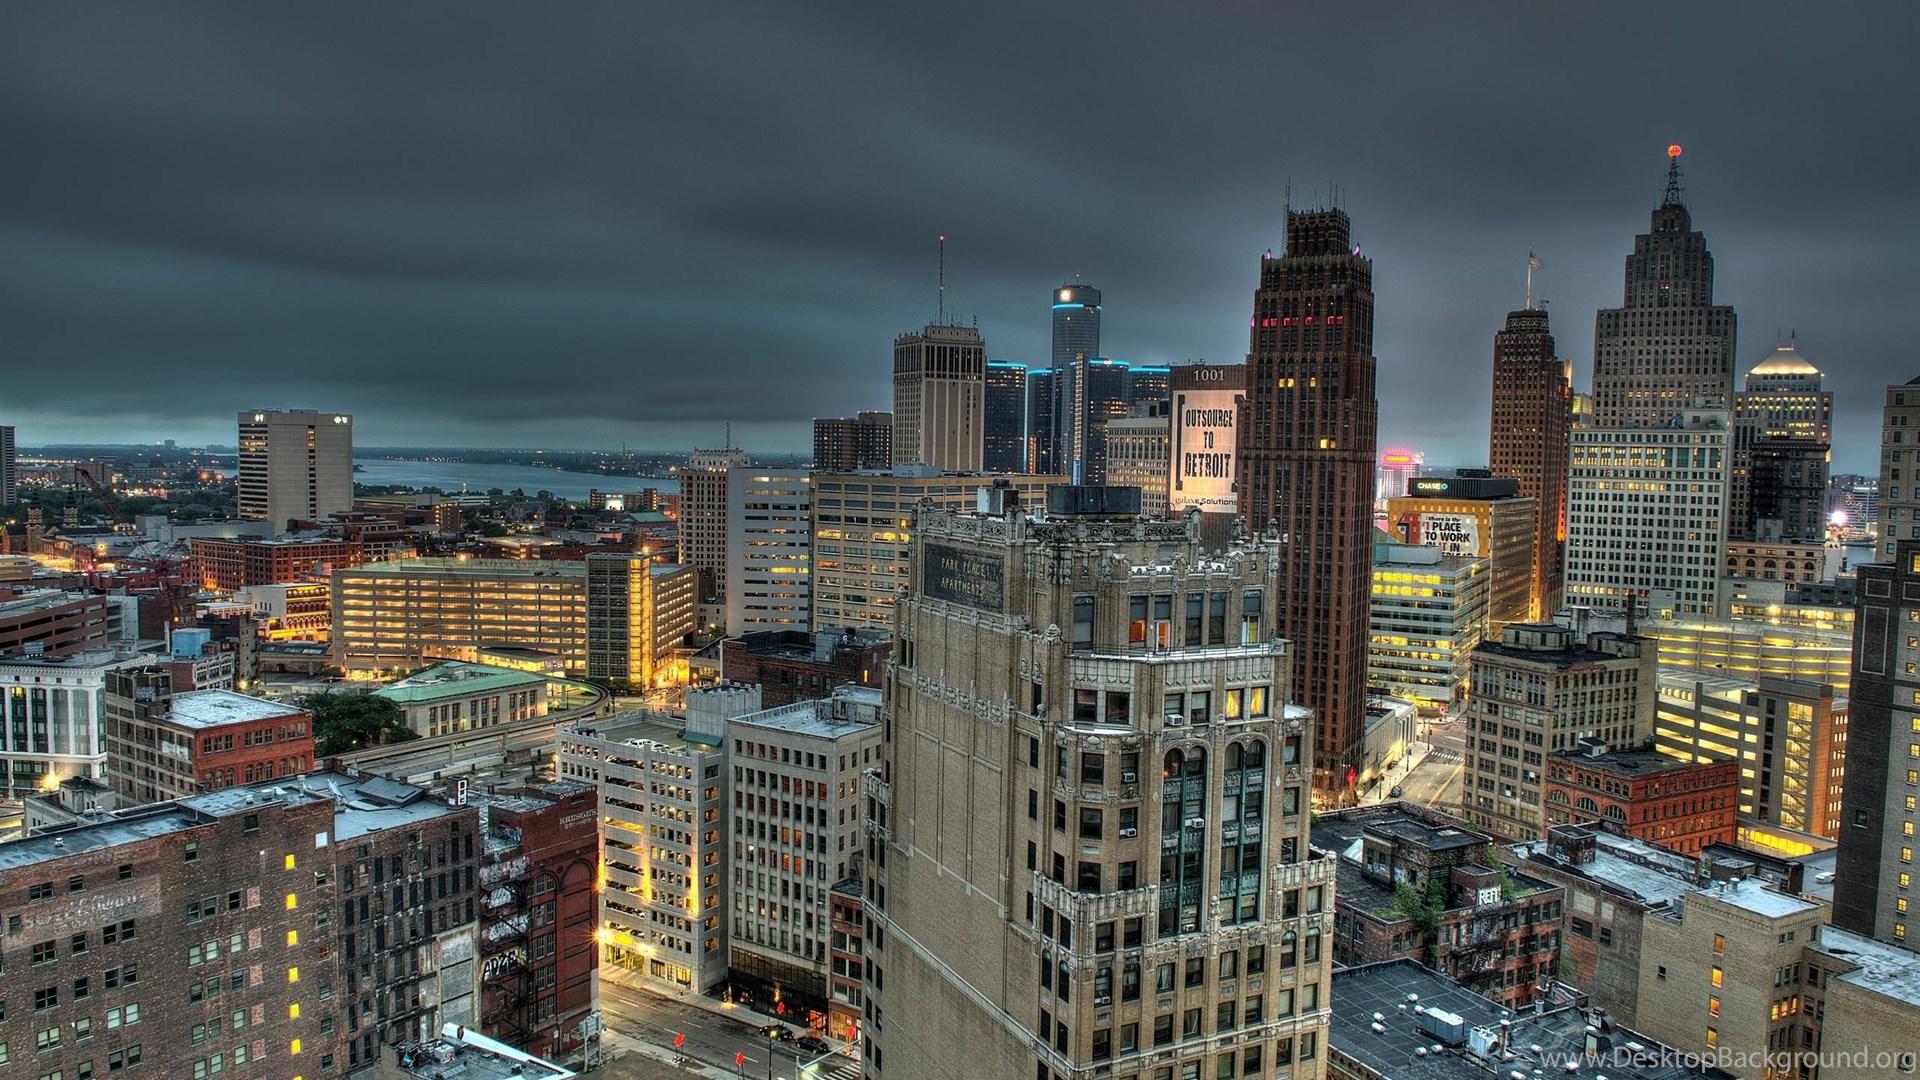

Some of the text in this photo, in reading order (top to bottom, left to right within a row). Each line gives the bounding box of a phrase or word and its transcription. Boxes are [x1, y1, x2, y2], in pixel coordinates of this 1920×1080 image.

[1194, 369, 1225, 381] 1001
[1185, 409, 1233, 428] OUTSOURCE
[1203, 431, 1214, 449] TO
[1184, 452, 1231, 479] DETROIT
[1417, 482, 1441, 490] CHASE
[1432, 521, 1462, 532] PLACE
[1425, 531, 1471, 543] TO WORK
[1450, 542, 1460, 552] IN
[942, 557, 959, 569] PARK
